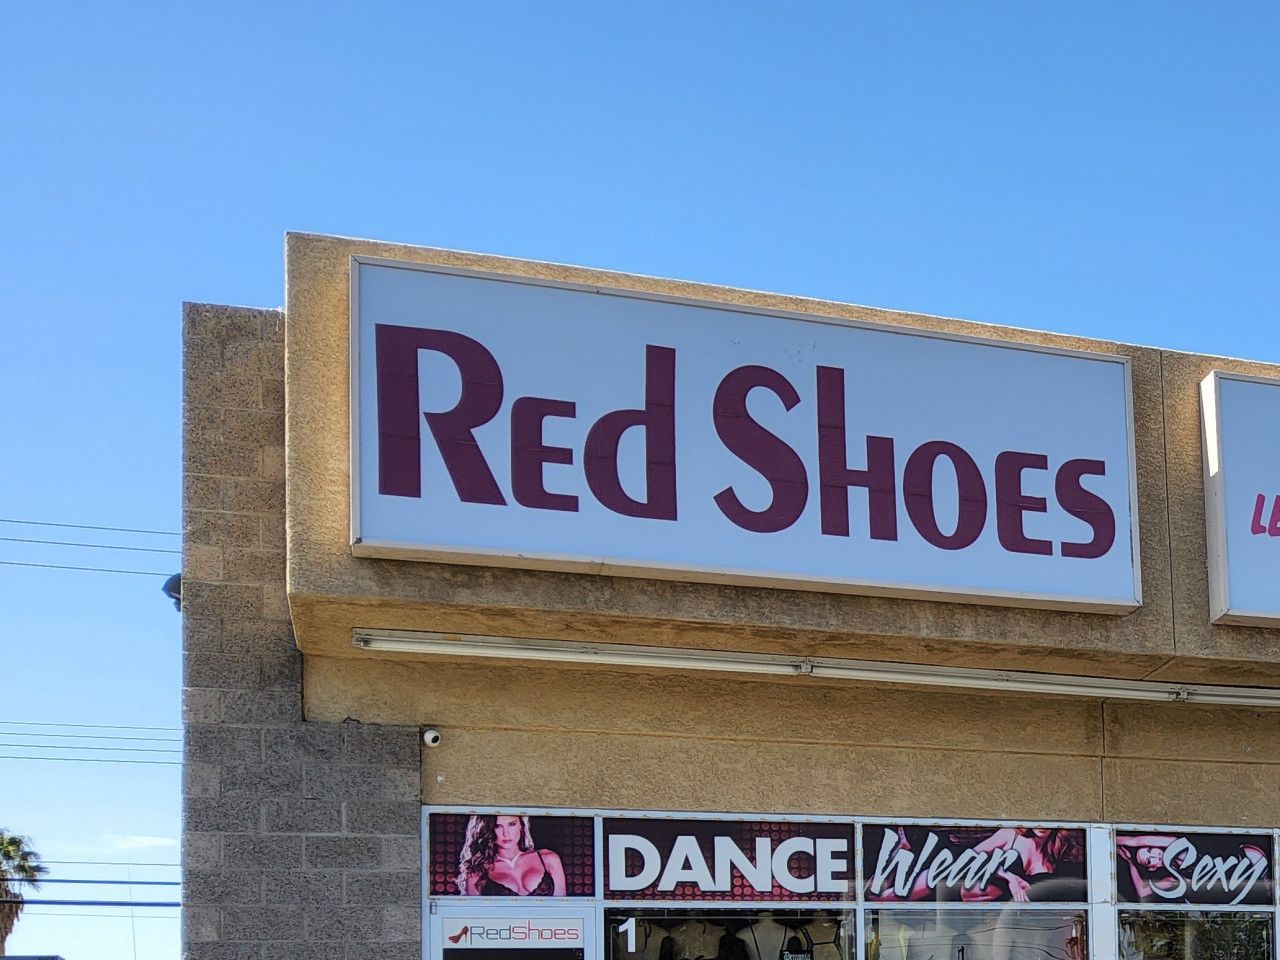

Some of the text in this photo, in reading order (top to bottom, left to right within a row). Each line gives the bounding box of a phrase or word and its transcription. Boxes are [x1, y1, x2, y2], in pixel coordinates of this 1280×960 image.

[608, 833, 847, 894] DANCE
[871, 828, 1022, 896] Wear
[1151, 836, 1268, 904] Sexy
[618, 917, 636, 953] 1
